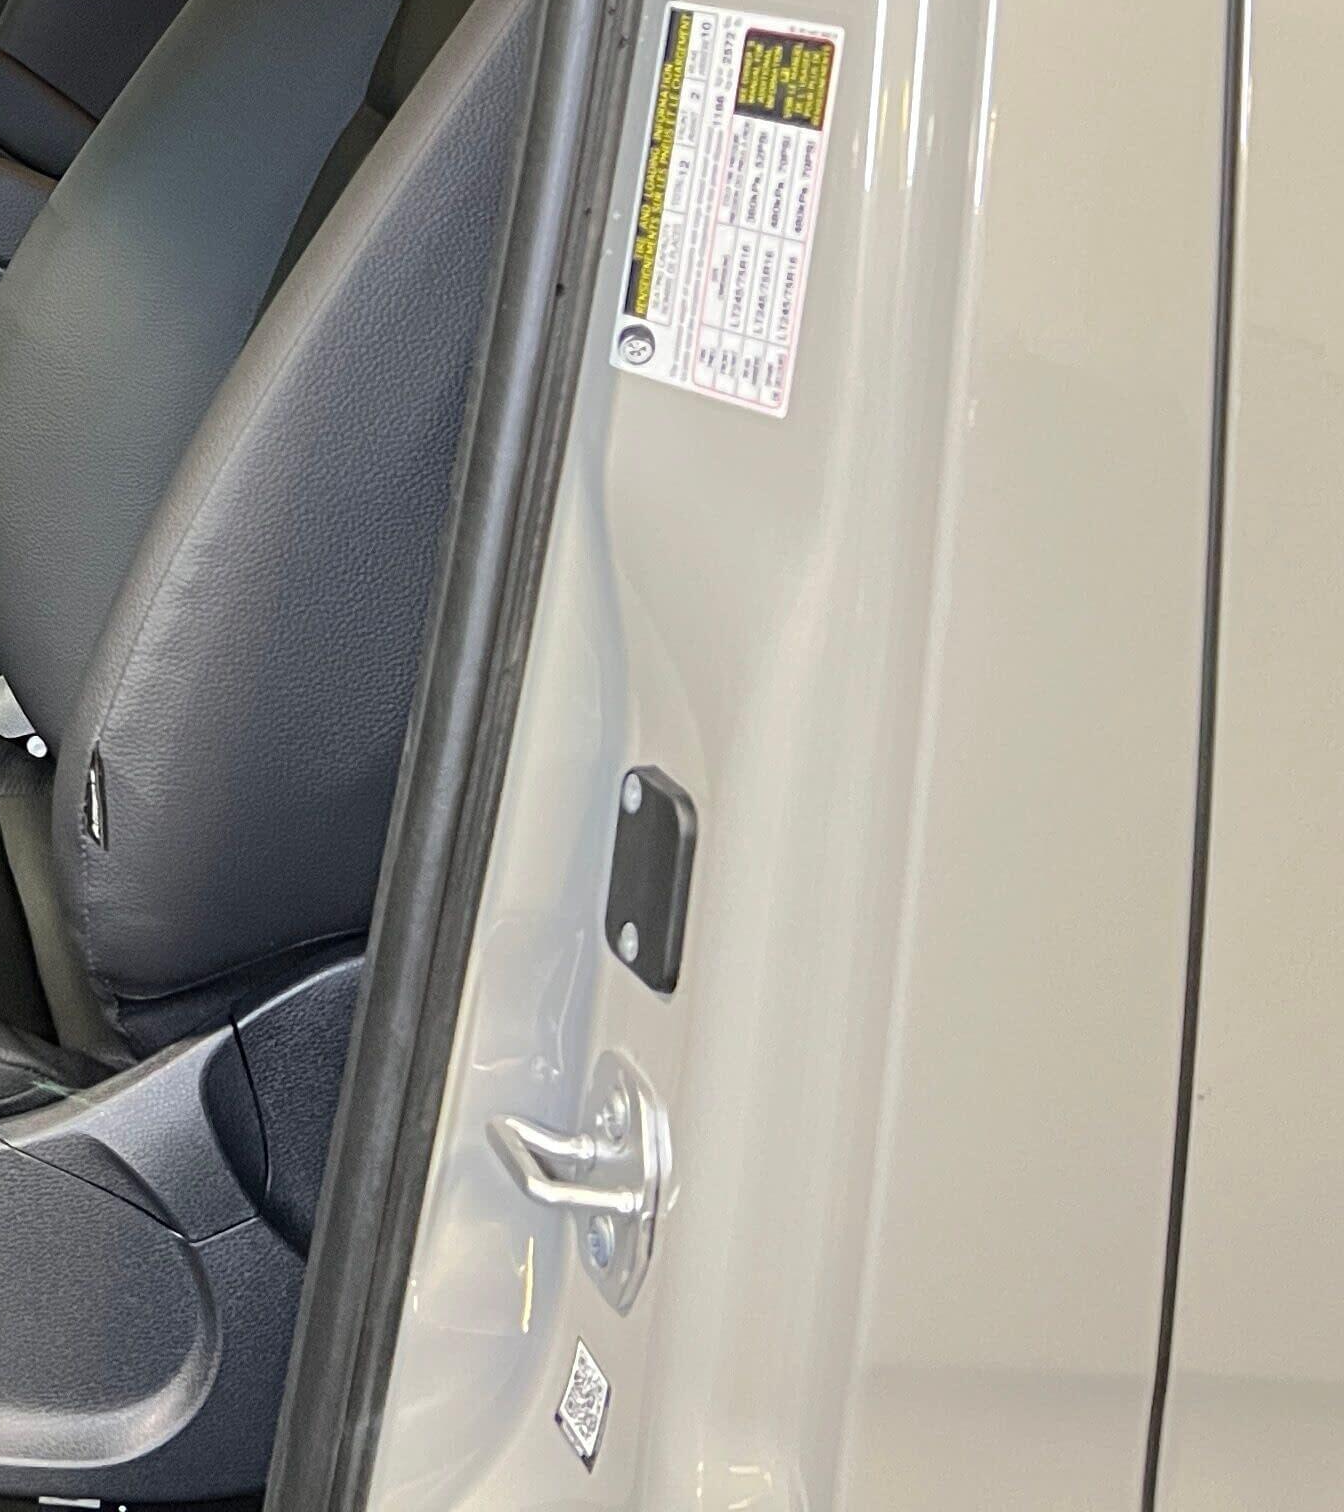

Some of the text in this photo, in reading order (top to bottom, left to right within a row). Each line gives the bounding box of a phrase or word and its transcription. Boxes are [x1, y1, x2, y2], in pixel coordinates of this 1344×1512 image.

[700, 21, 712, 37] 10
[722, 31, 735, 64] 2572
[690, 91, 700, 100] 2
[633, 63, 673, 260] TIRE AND LOADING INFORMATION
[634, 13, 692, 314] RENSEIGNEMENTS SUR LES PNEUS ET LE CHARGEMENT
[677, 158, 689, 176] 12
